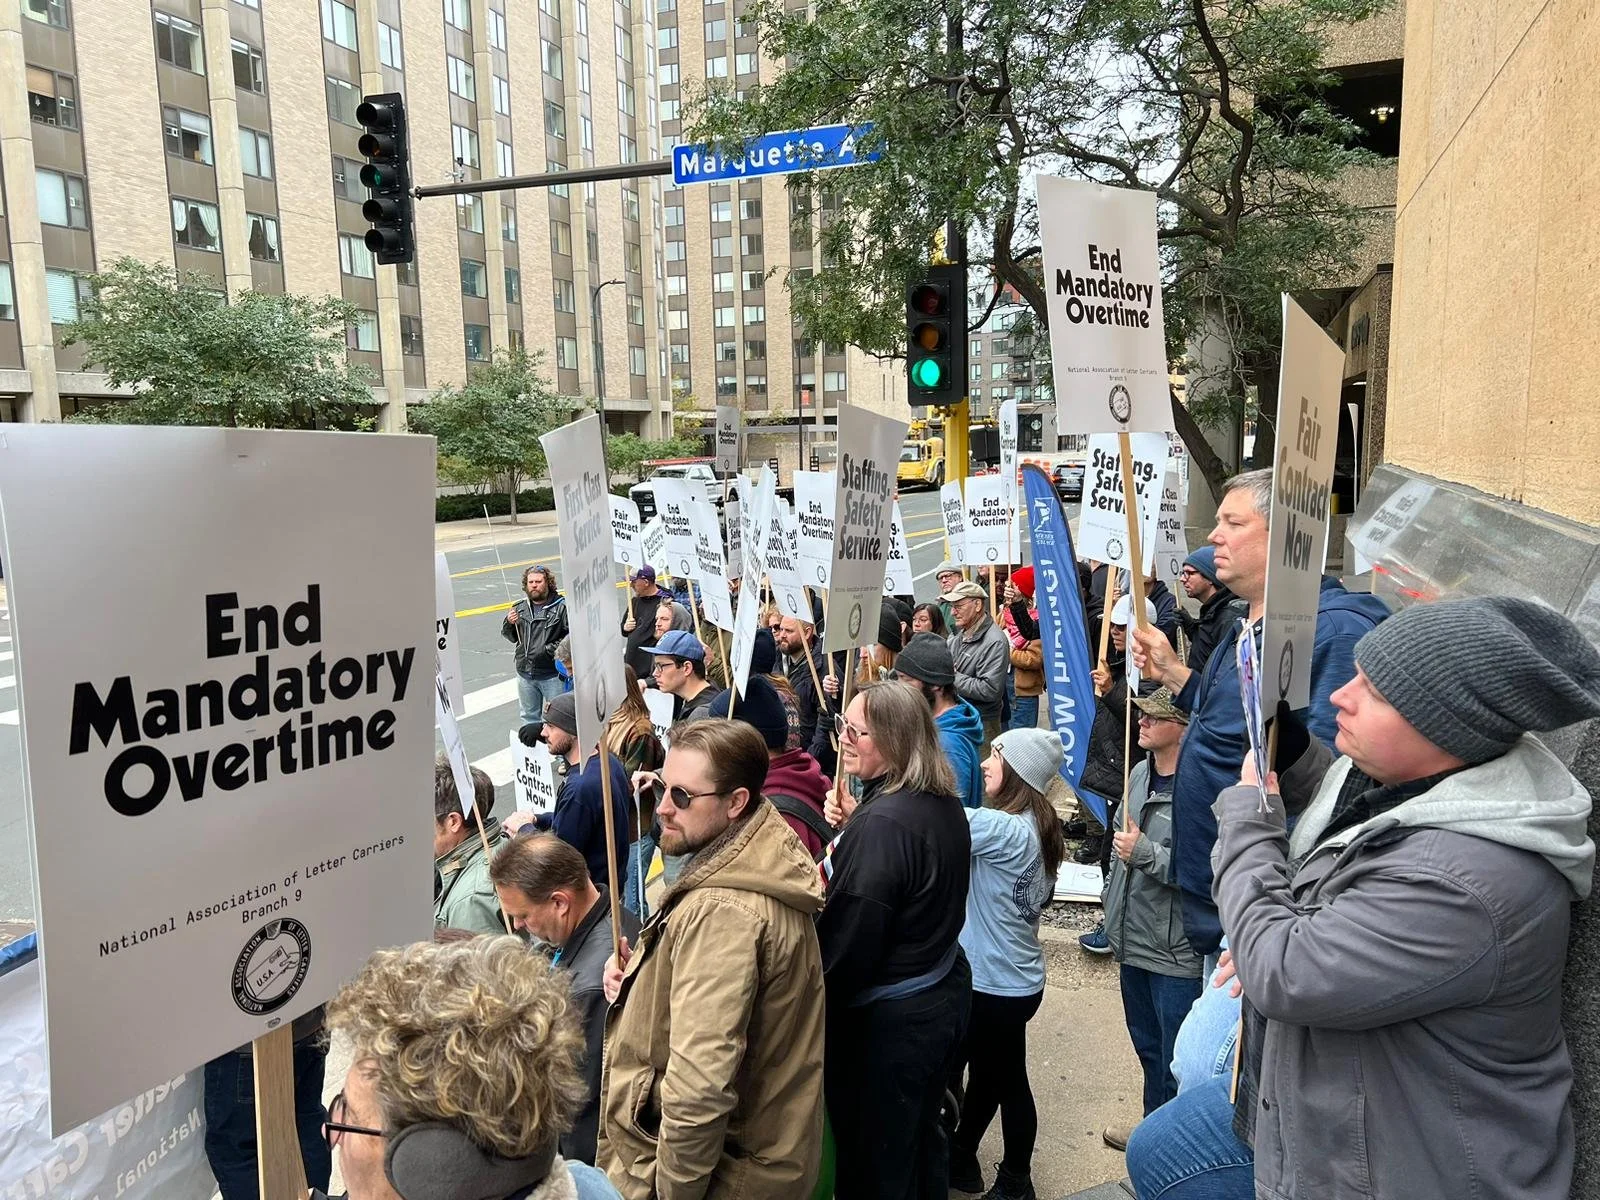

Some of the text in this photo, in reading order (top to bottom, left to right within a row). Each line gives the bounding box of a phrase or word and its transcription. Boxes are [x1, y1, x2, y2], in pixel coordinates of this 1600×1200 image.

[1088, 243, 1122, 274] End
[1056, 268, 1153, 309] Mandatory
[1066, 296, 1150, 328] Overtime
[1297, 396, 1321, 462] Fair
[842, 453, 890, 502] Staffing.
[1092, 448, 1158, 482] Stafng.
[563, 471, 602, 521] First Class
[1278, 446, 1329, 522] Contract
[614, 509, 628, 521] Fair
[667, 503, 680, 515] End
[809, 501, 822, 514] End
[844, 490, 884, 535] Safety.
[969, 507, 1015, 518] Mandatoy
[982, 497, 999, 507] End
[1160, 501, 1177, 512] ervice
[573, 510, 602, 557] Service
[611, 520, 639, 533] ontract
[614, 529, 632, 541] Now
[661, 514, 690, 526] Mandator
[798, 511, 834, 531] Mandatory
[802, 525, 834, 541] Overtime
[838, 525, 882, 561] Service.
[1166, 531, 1176, 544] Pay
[1283, 512, 1313, 571] Now
[695, 544, 721, 566] Mandatory
[573, 555, 609, 613] First Class
[206, 583, 321, 659] End
[69, 647, 416, 756] Mandatory
[104, 709, 397, 817] Overtime
[525, 756, 541, 776] Fair
[516, 768, 552, 797] Contract
[526, 787, 545, 808] Now
[99, 834, 404, 957] National Association of Letter Carriers
[242, 889, 303, 924] Branch 9
[235, 935, 262, 988] ASSOCIATION
[286, 956, 309, 997] CARRIERS
[238, 989, 264, 1012] NATIONAL
